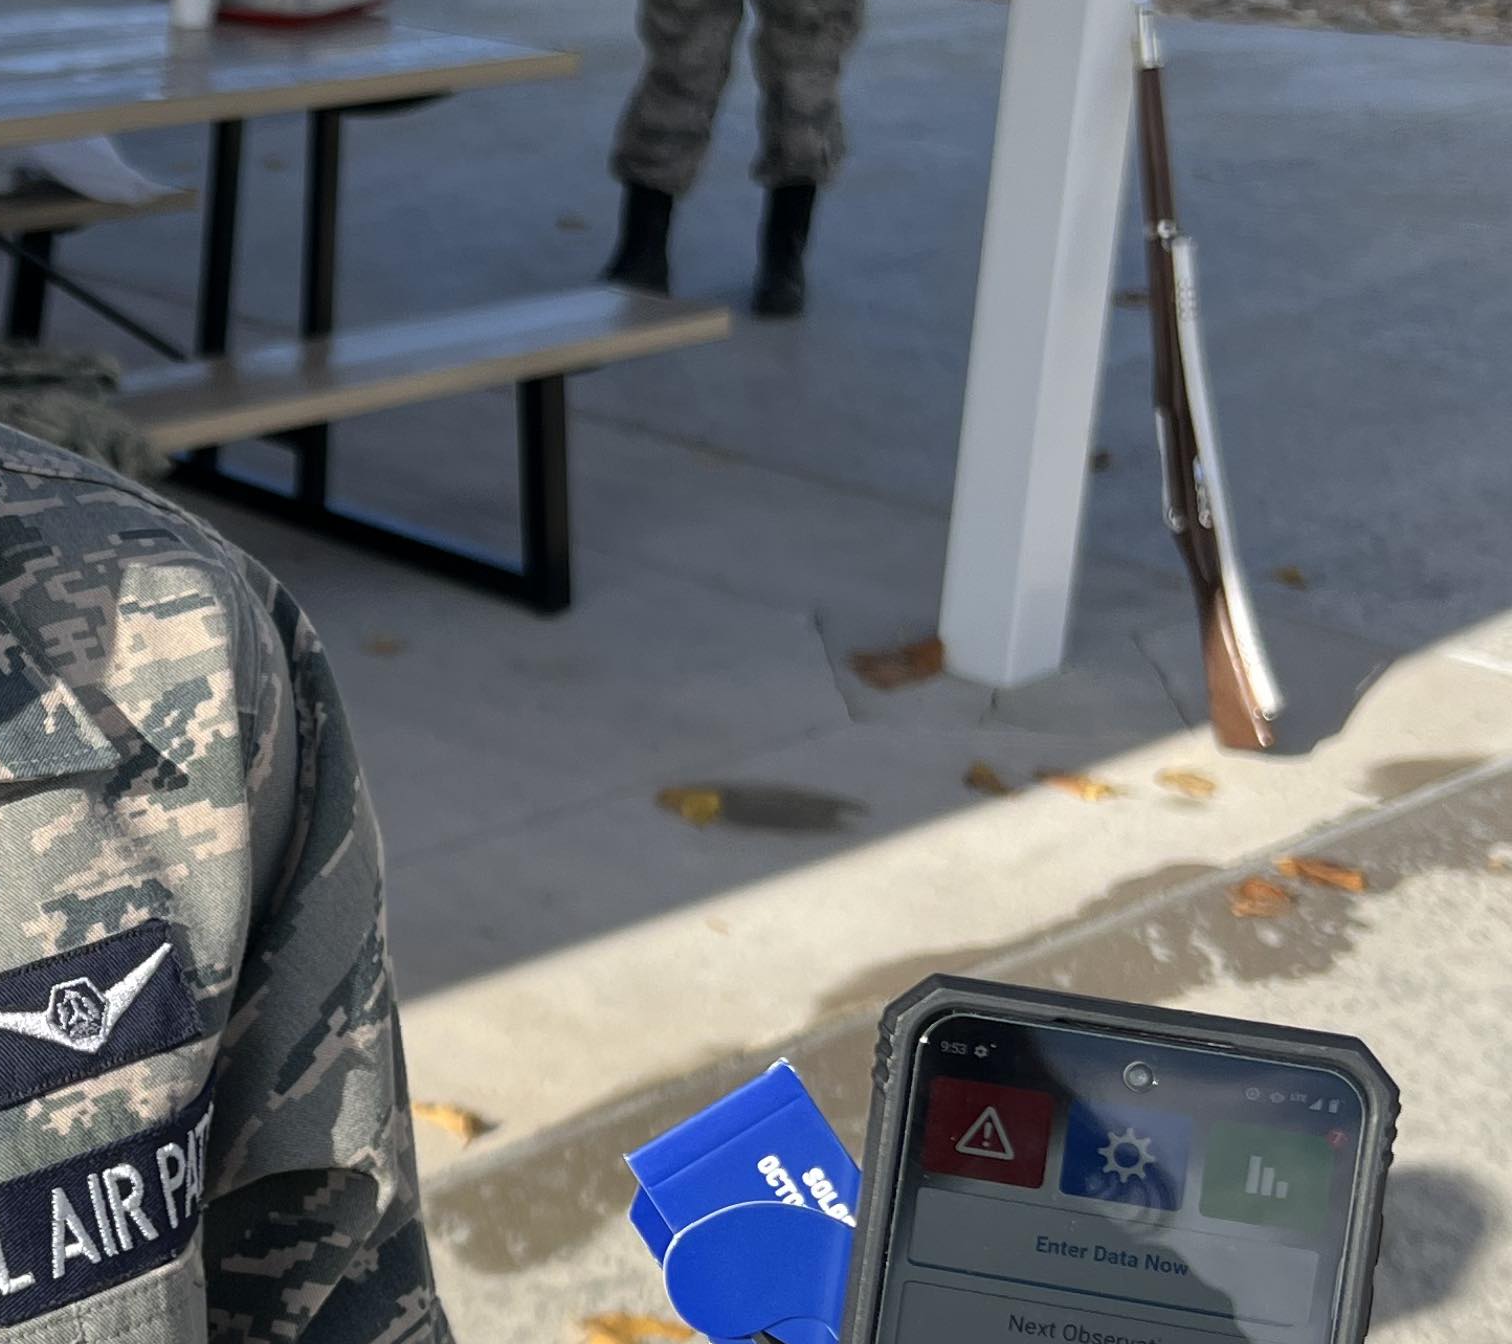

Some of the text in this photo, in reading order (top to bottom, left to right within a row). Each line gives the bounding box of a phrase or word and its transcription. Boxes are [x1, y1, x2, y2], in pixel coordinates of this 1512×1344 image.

[940, 1040, 968, 1055] 9:53
[756, 1155, 807, 1208] OCTO
[51, 1162, 160, 1280] AIR
[1035, 1235, 1189, 1276] Enter Data Now
[1008, 1315, 1057, 1339] Next
